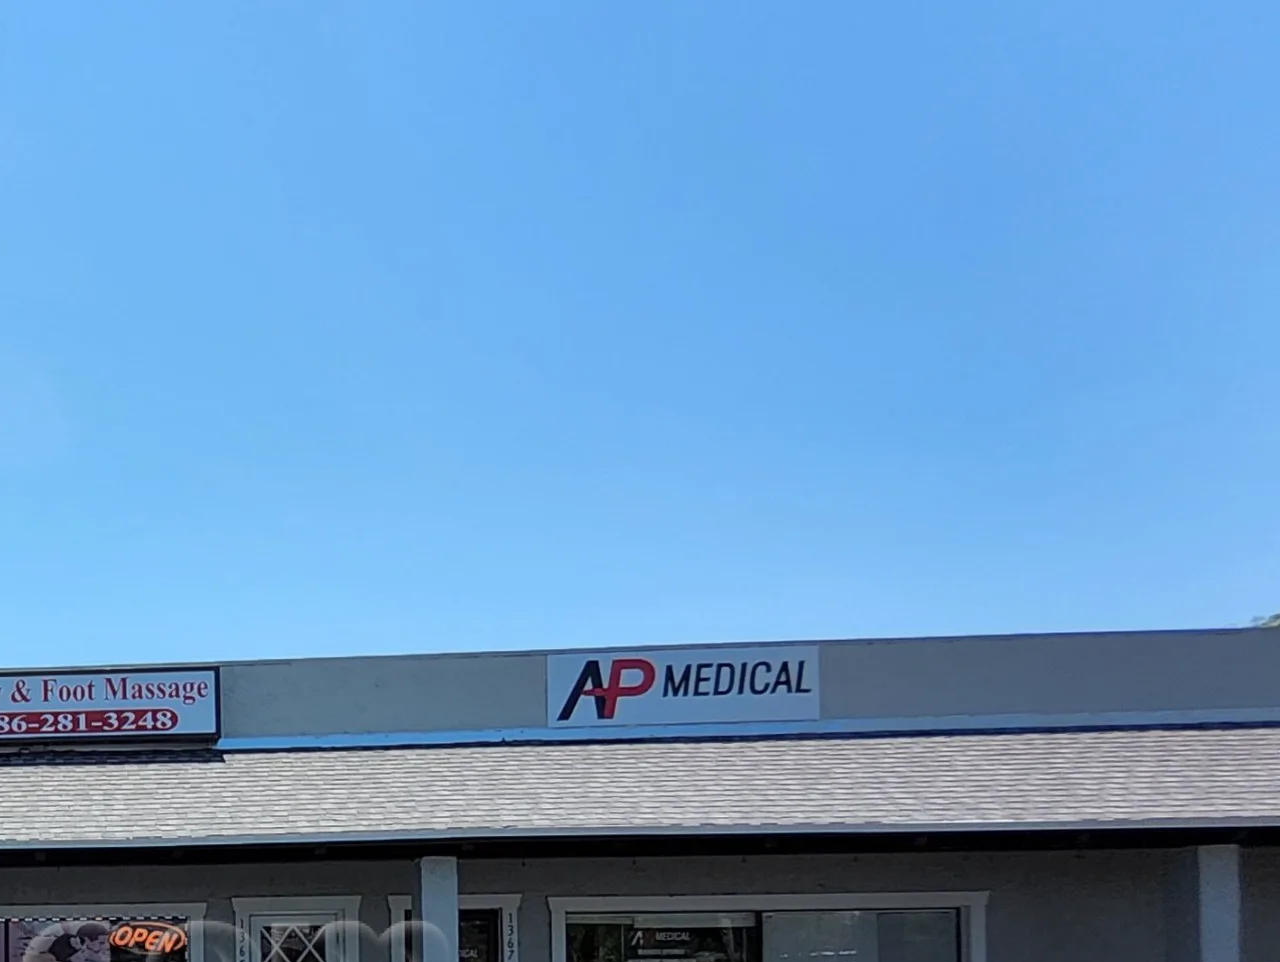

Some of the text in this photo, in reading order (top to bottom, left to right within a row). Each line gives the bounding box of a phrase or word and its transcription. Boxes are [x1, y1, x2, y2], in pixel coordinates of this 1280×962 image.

[11, 679, 32, 702] &
[41, 679, 96, 702] Foot
[103, 676, 209, 705] Massage
[556, 659, 812, 721] AP MEDICAL
[114, 925, 178, 954] OPEN
[506, 911, 514, 962] 1367
